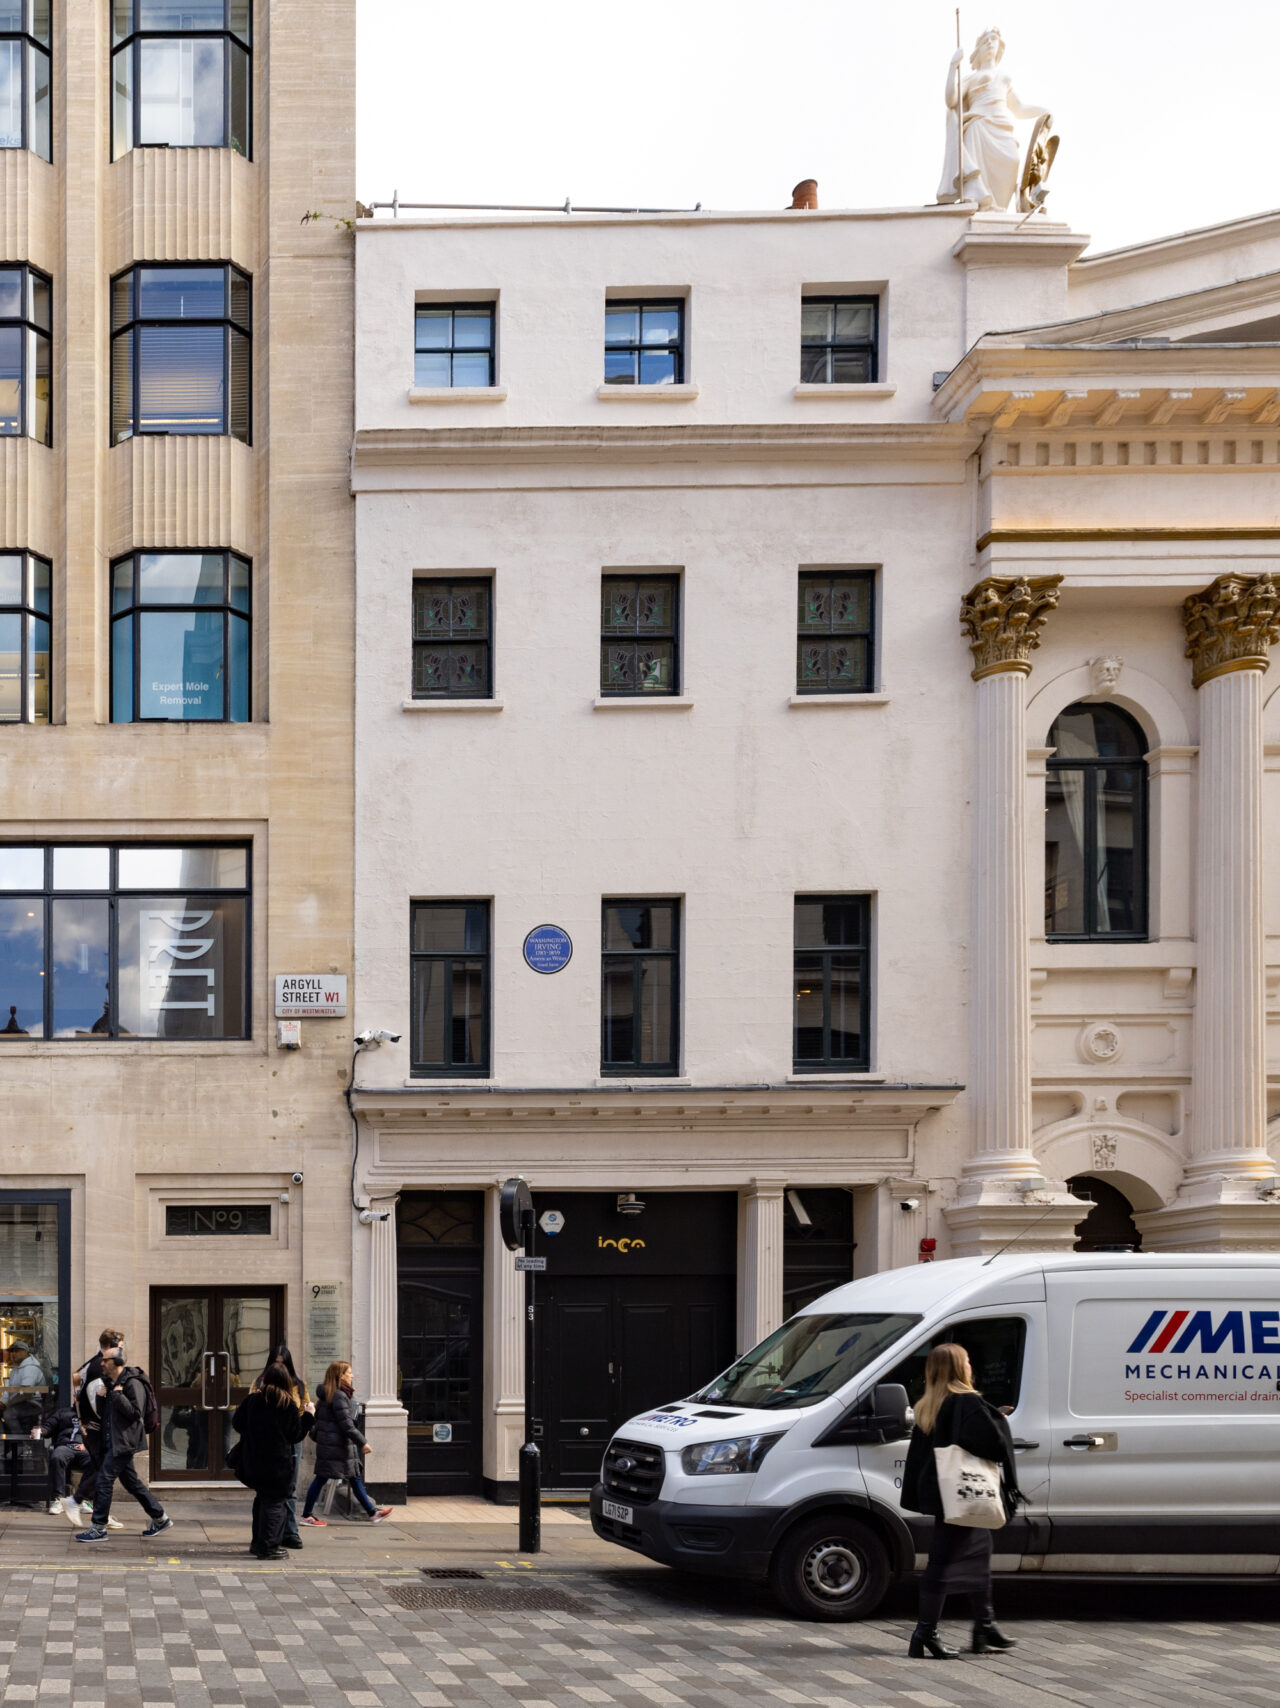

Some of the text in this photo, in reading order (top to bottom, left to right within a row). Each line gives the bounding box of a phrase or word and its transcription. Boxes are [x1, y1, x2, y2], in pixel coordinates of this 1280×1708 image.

[152, 682, 209, 692] Expert Mole
[160, 696, 202, 705] Removal
[148, 910, 214, 1016] PRET
[282, 979, 323, 990] ARGYLL
[282, 992, 340, 1002] STREET W1
[312, 1285, 320, 1298] 9
[1126, 1364, 1280, 1380] MECHANICAL
[1124, 1390, 1280, 1404] Specialist commercial drain
[605, 1503, 629, 1520] LG71 SZP
